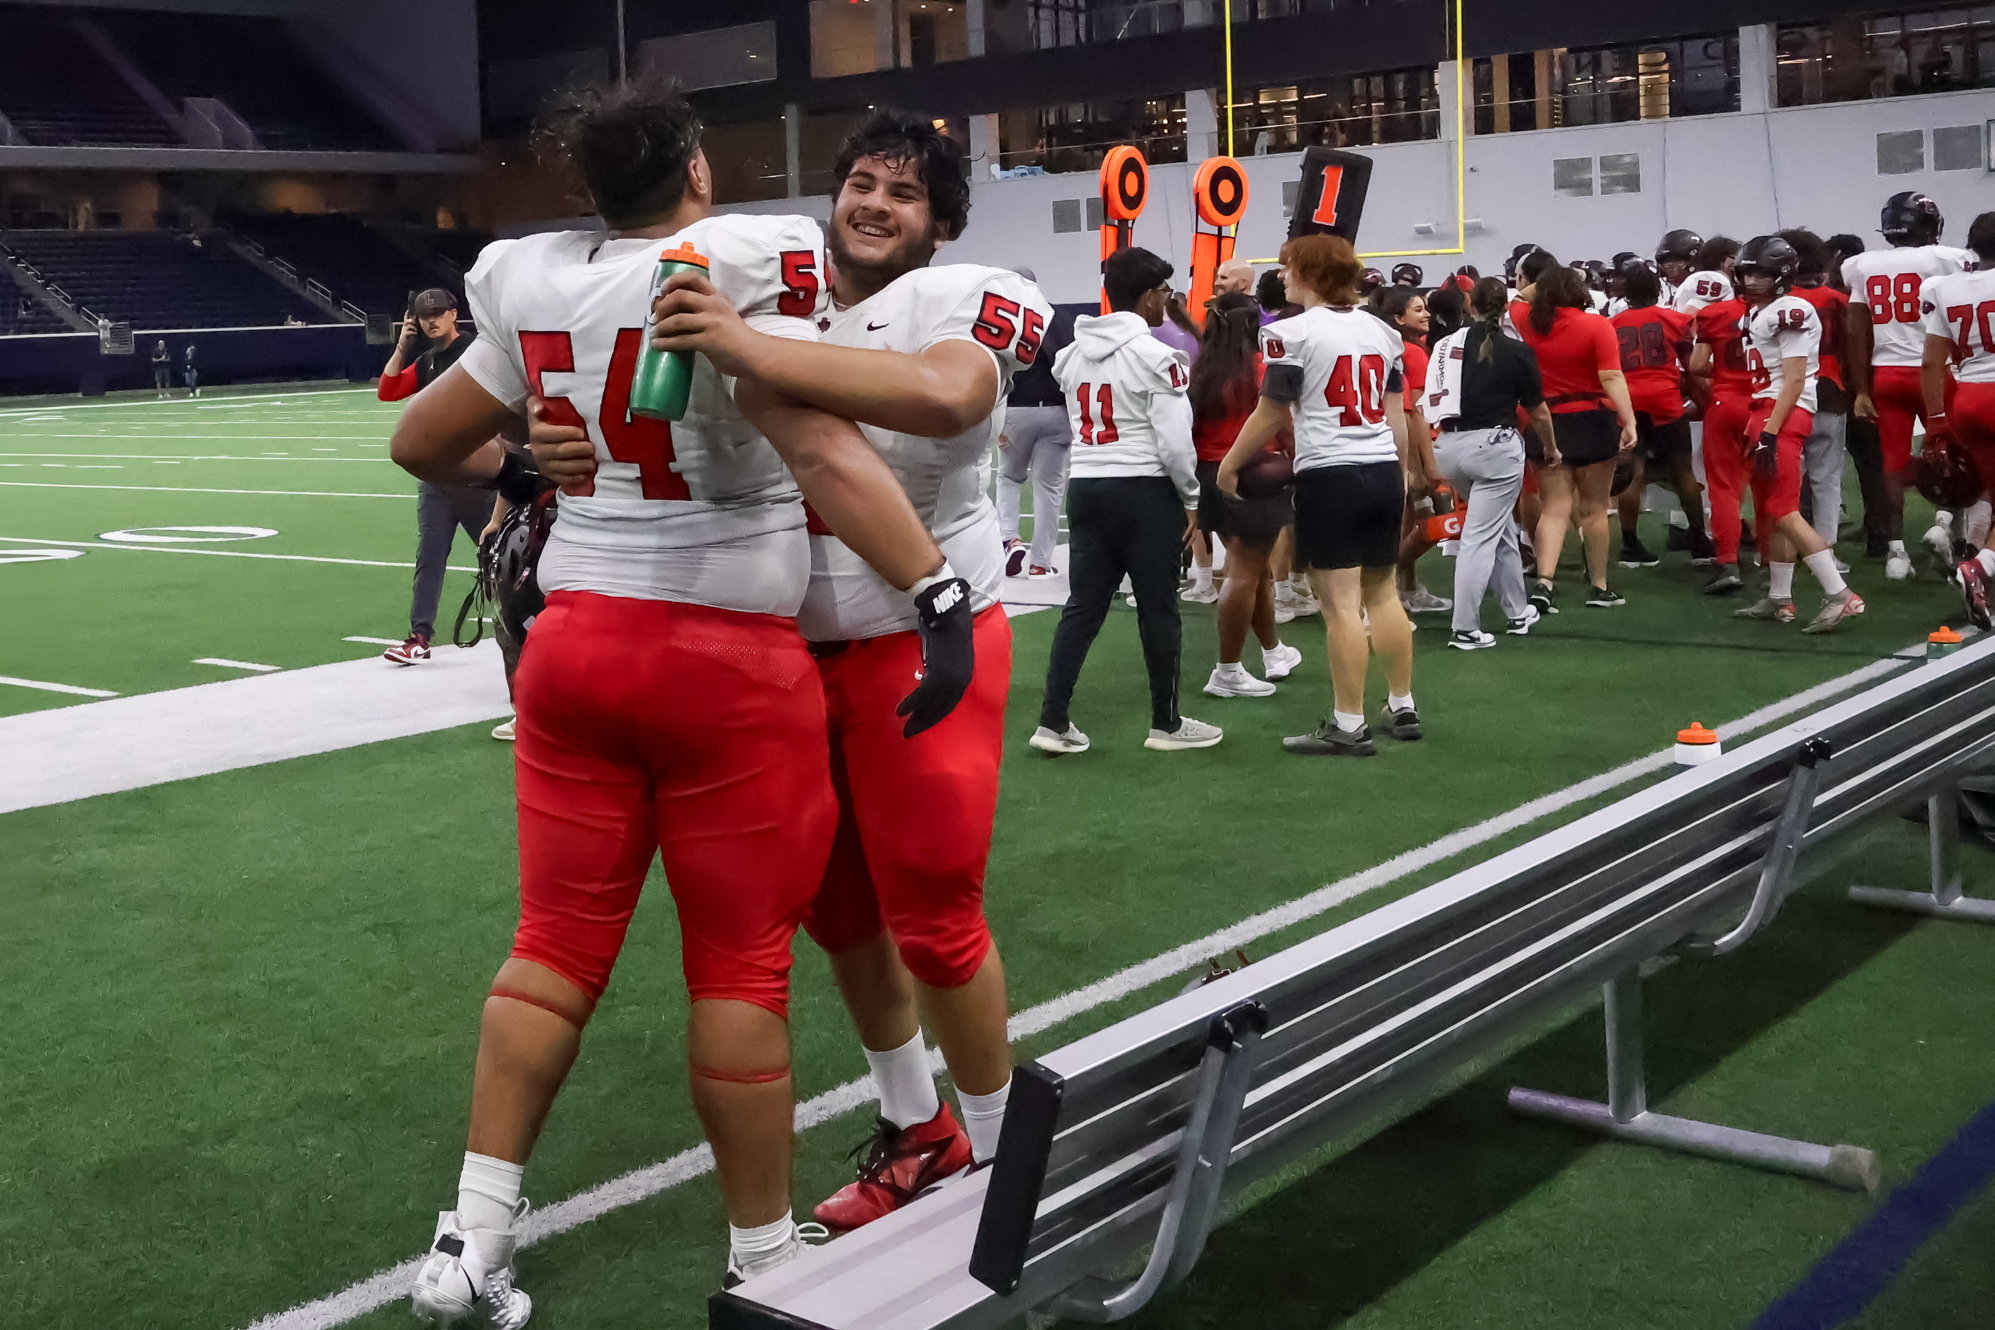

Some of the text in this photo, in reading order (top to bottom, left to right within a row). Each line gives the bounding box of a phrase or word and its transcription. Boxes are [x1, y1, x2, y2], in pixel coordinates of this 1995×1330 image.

[1312, 166, 1343, 226] 1
[777, 250, 831, 317] 5
[1696, 279, 1723, 297] 59
[1866, 273, 1922, 324] 88
[971, 291, 1044, 365] 55
[1616, 322, 1667, 373] 28
[1777, 308, 1805, 331] 19
[1946, 299, 1995, 357] 70
[518, 327, 692, 501] 54
[1077, 382, 1119, 446] 11
[1324, 354, 1385, 427] 40
[1444, 517, 1460, 534] G
[933, 582, 964, 614] NIKE
